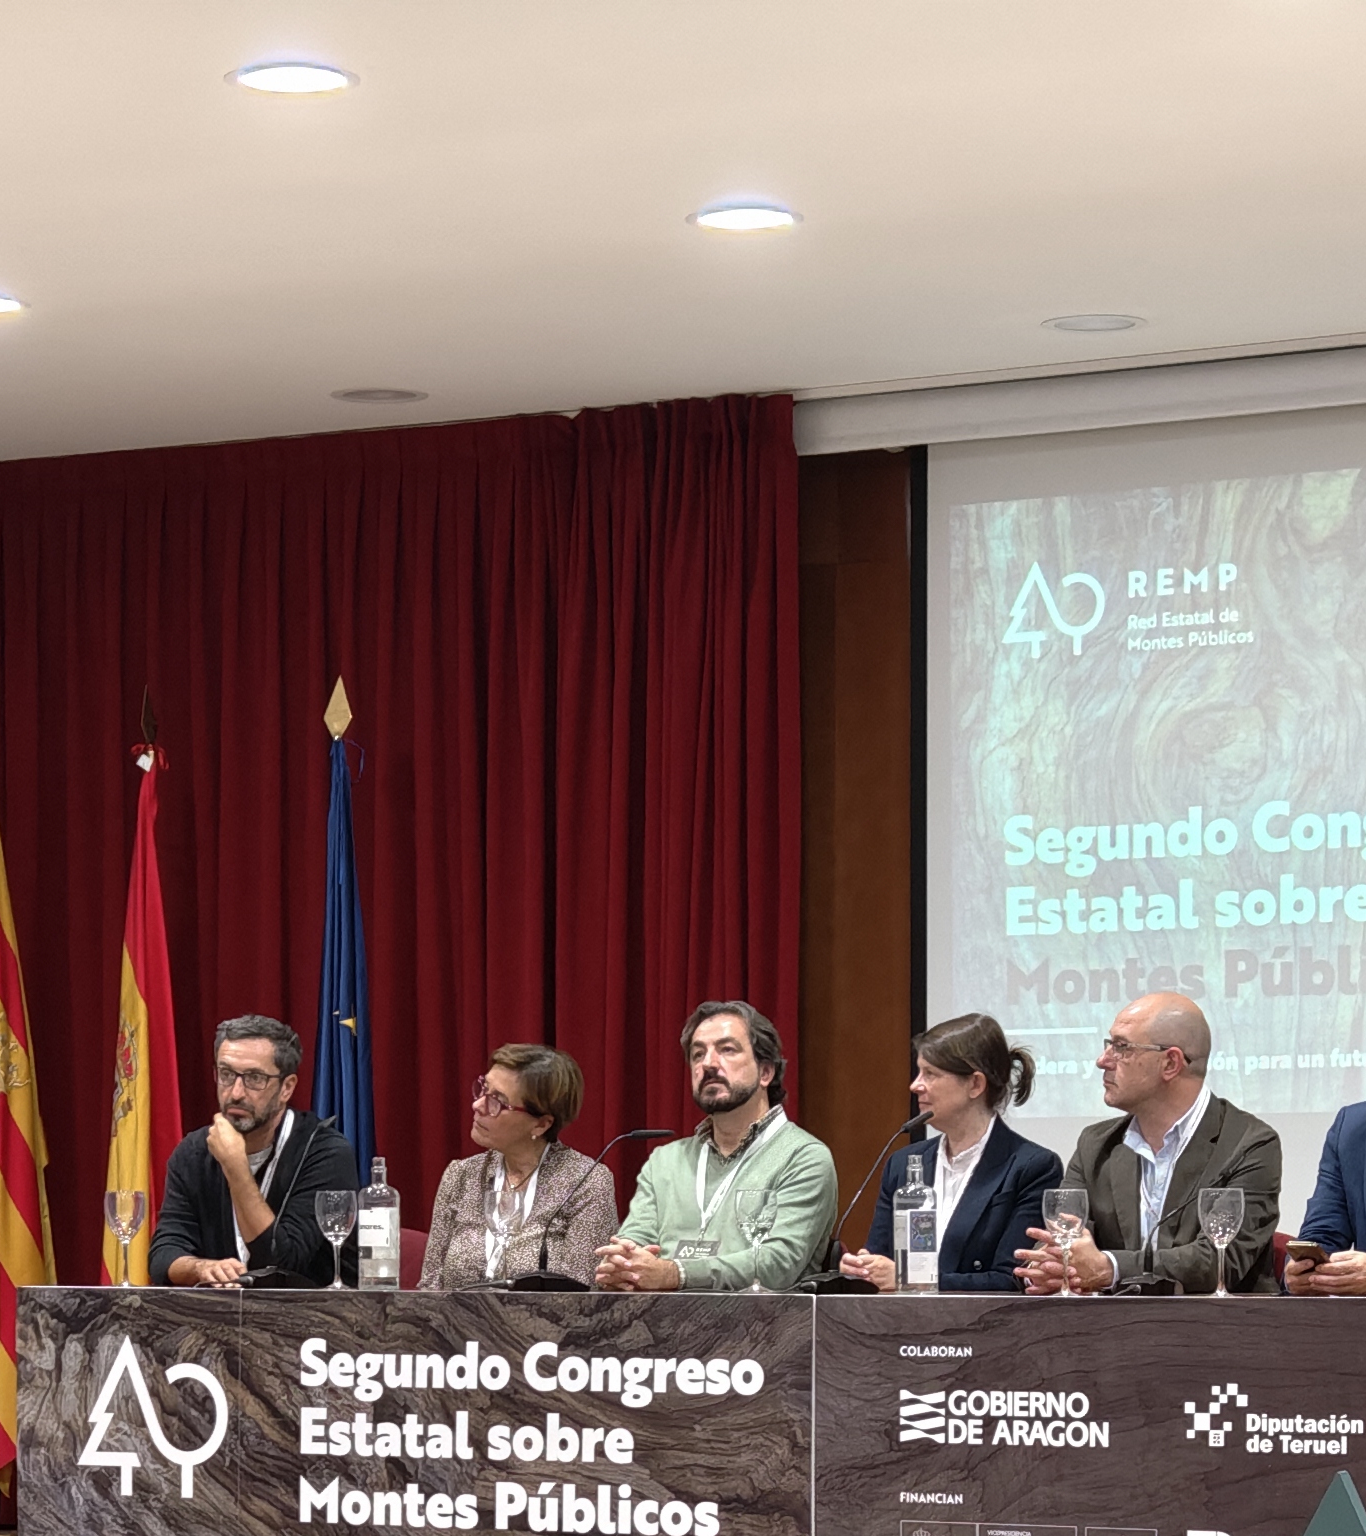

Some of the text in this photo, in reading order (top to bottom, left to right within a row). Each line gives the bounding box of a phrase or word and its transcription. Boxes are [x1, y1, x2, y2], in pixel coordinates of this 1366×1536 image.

[1127, 563, 1238, 599] REMP
[1127, 608, 1239, 630] Red Estatal de
[1127, 630, 1255, 651] Montes Públicos
[1002, 806, 1238, 878] Segundo
[1005, 878, 1200, 936] Estatal
[1005, 956, 1206, 1005] Montes
[1244, 1053, 1292, 1076] para
[1297, 1051, 1325, 1069] un
[899, 1345, 973, 1359] COLABORAN
[299, 1337, 765, 1408] Segundo Congreso
[947, 1388, 1090, 1419] GOBIERNO
[299, 1406, 635, 1465] Estatal sobre
[947, 1418, 1110, 1449] DE ARAGON
[1245, 1412, 1364, 1437] Diputación
[1245, 1435, 1348, 1455] de Teruel
[298, 1475, 479, 1530] Montes
[899, 1491, 964, 1505] FINANCIAN
